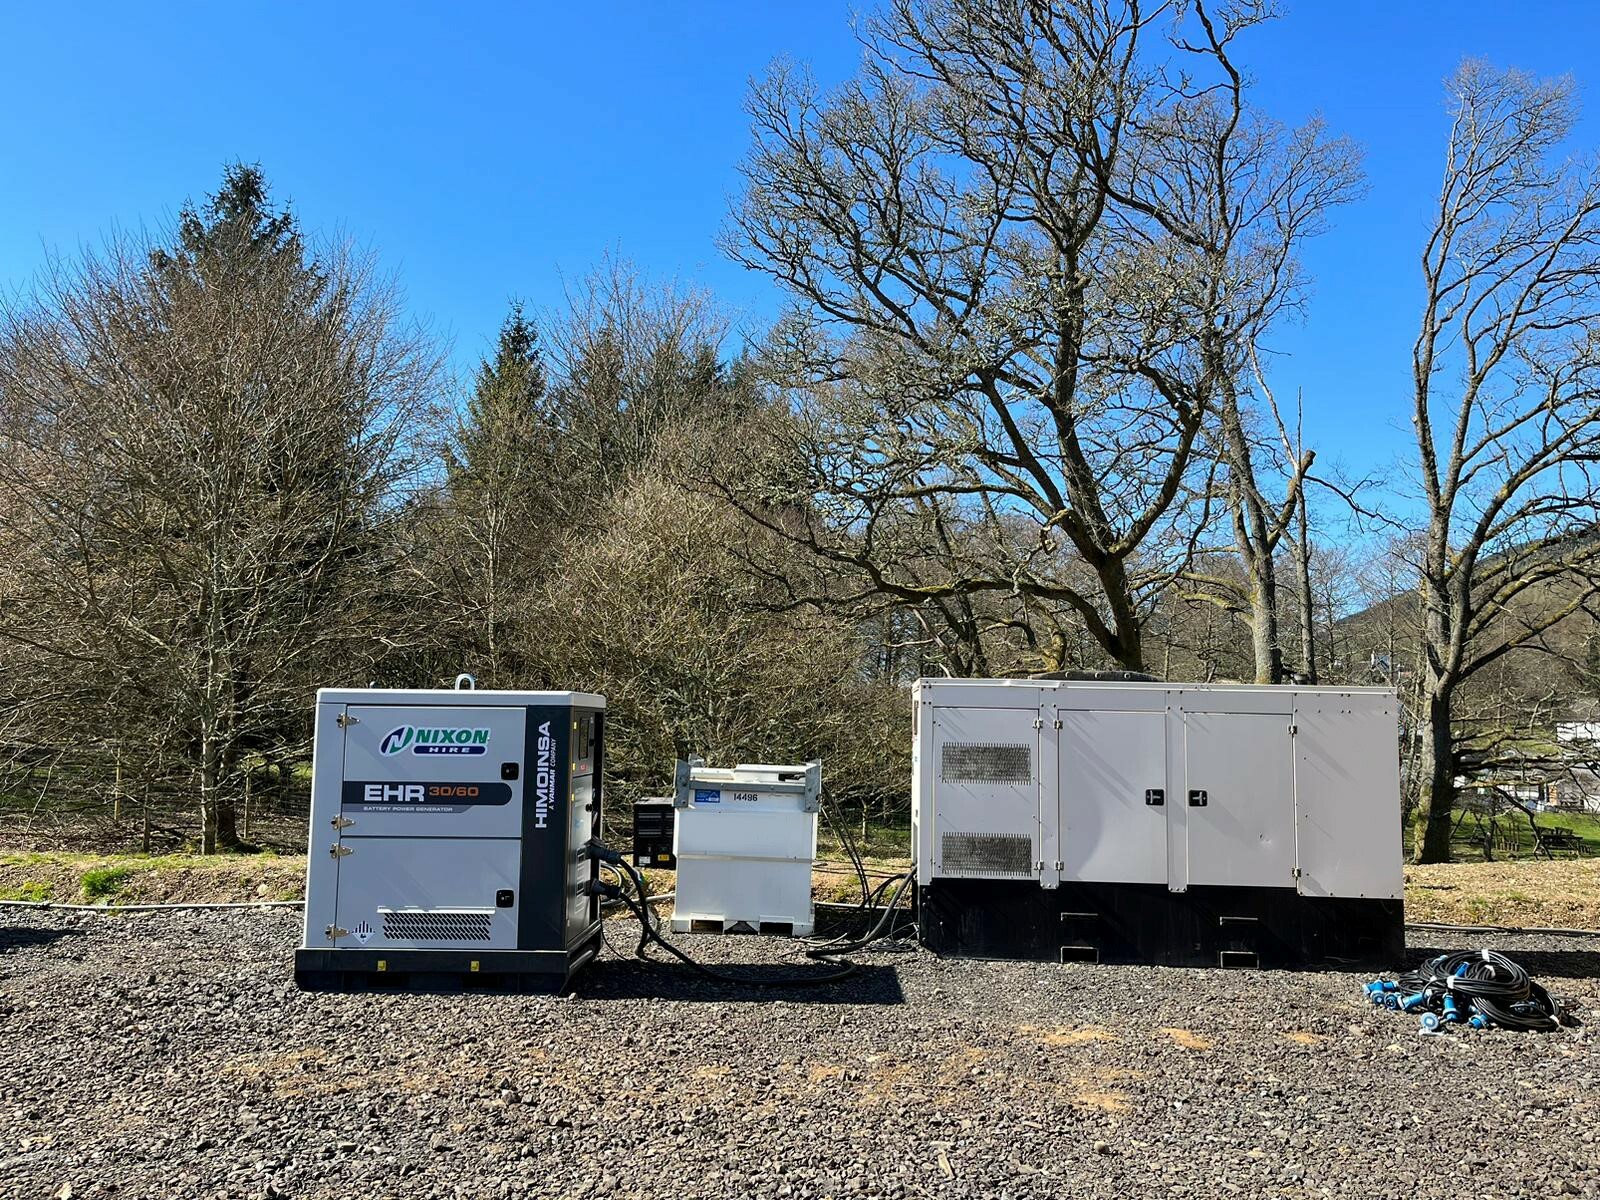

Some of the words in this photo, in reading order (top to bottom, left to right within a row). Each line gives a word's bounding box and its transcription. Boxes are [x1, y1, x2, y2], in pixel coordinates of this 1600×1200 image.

[415, 729, 489, 744] NIXON
[535, 721, 551, 828] HIMOINSA
[364, 784, 425, 802] EHR
[429, 786, 479, 797] 30/60
